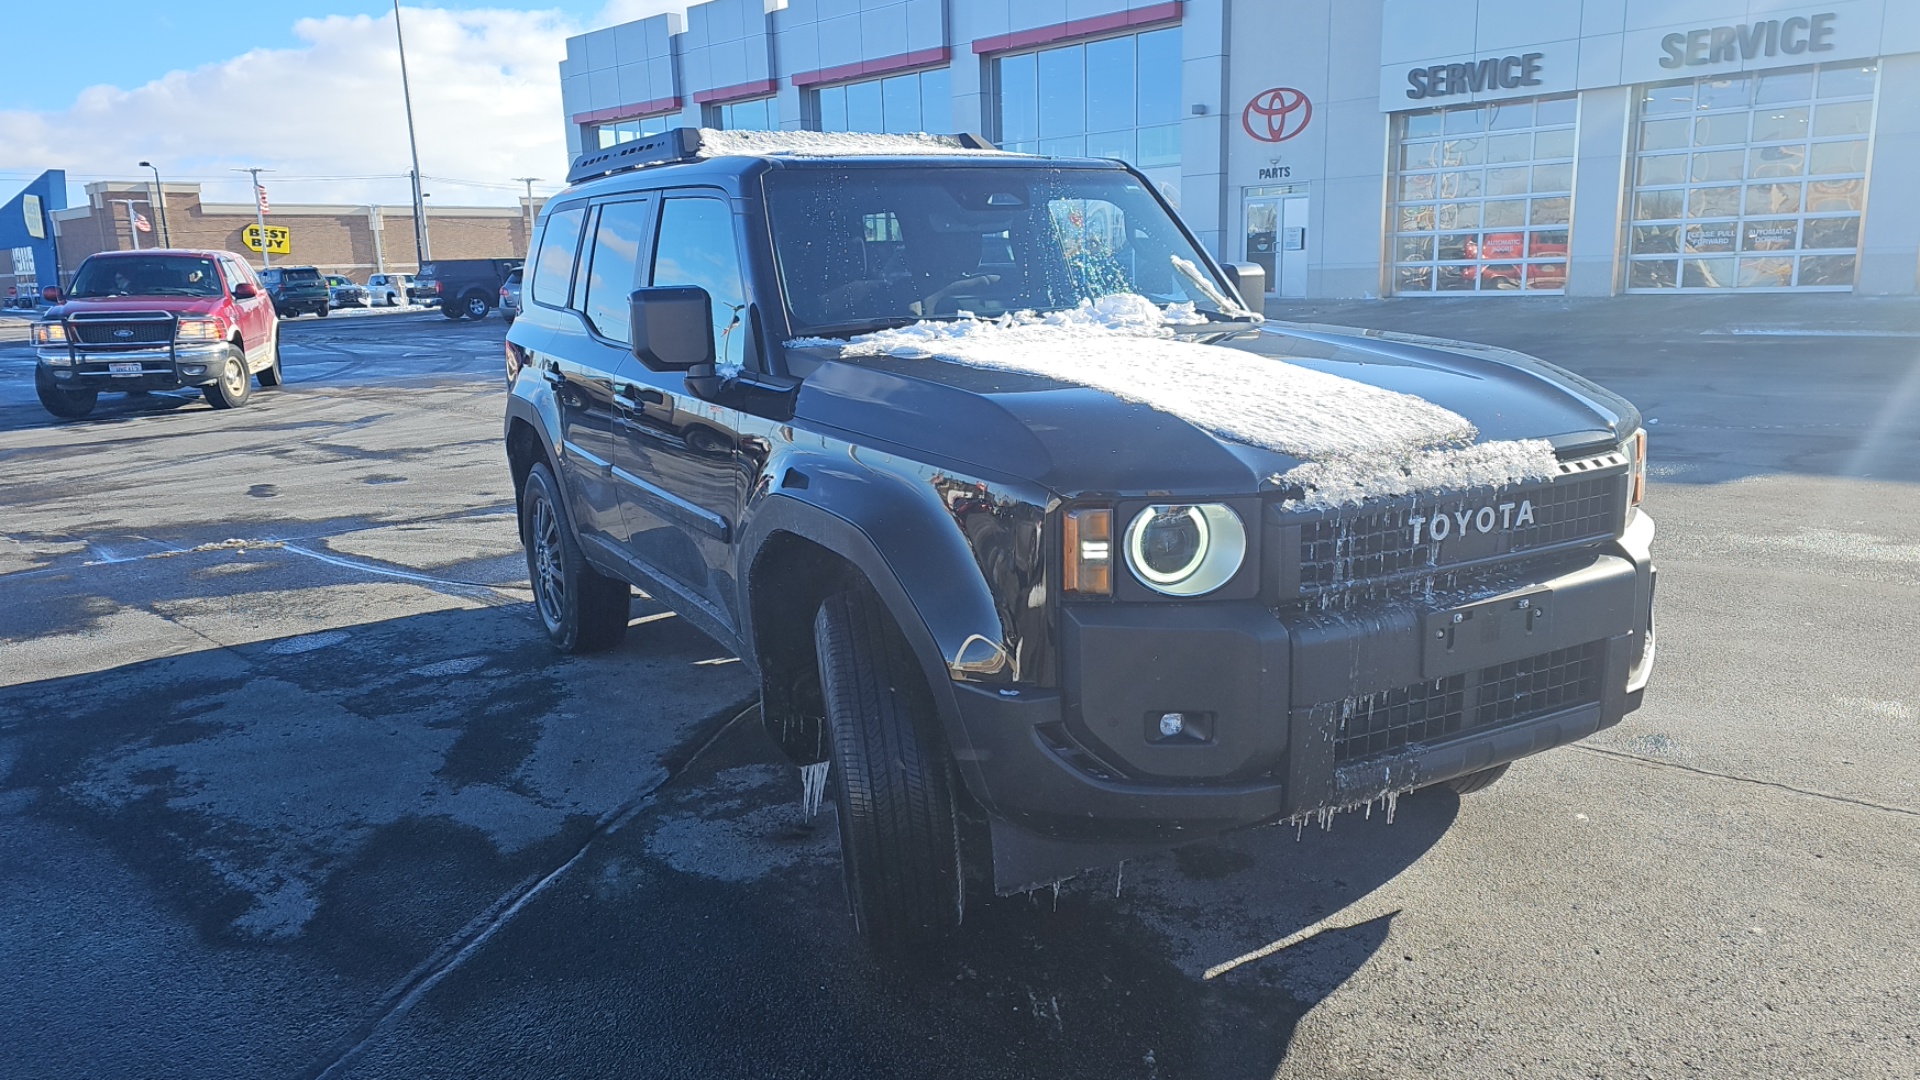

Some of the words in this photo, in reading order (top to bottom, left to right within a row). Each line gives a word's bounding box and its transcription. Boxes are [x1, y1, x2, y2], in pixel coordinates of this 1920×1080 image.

[1658, 12, 1837, 69] SERVICE
[1406, 52, 1544, 99] SERVICE
[1259, 166, 1291, 179] PARTS
[249, 228, 287, 239] BEST
[1748, 228, 1792, 236] AUTOMATIC
[251, 238, 284, 248] BUY
[1690, 237, 1729, 245] FORWARD
[1408, 500, 1534, 544] TOYOTA
